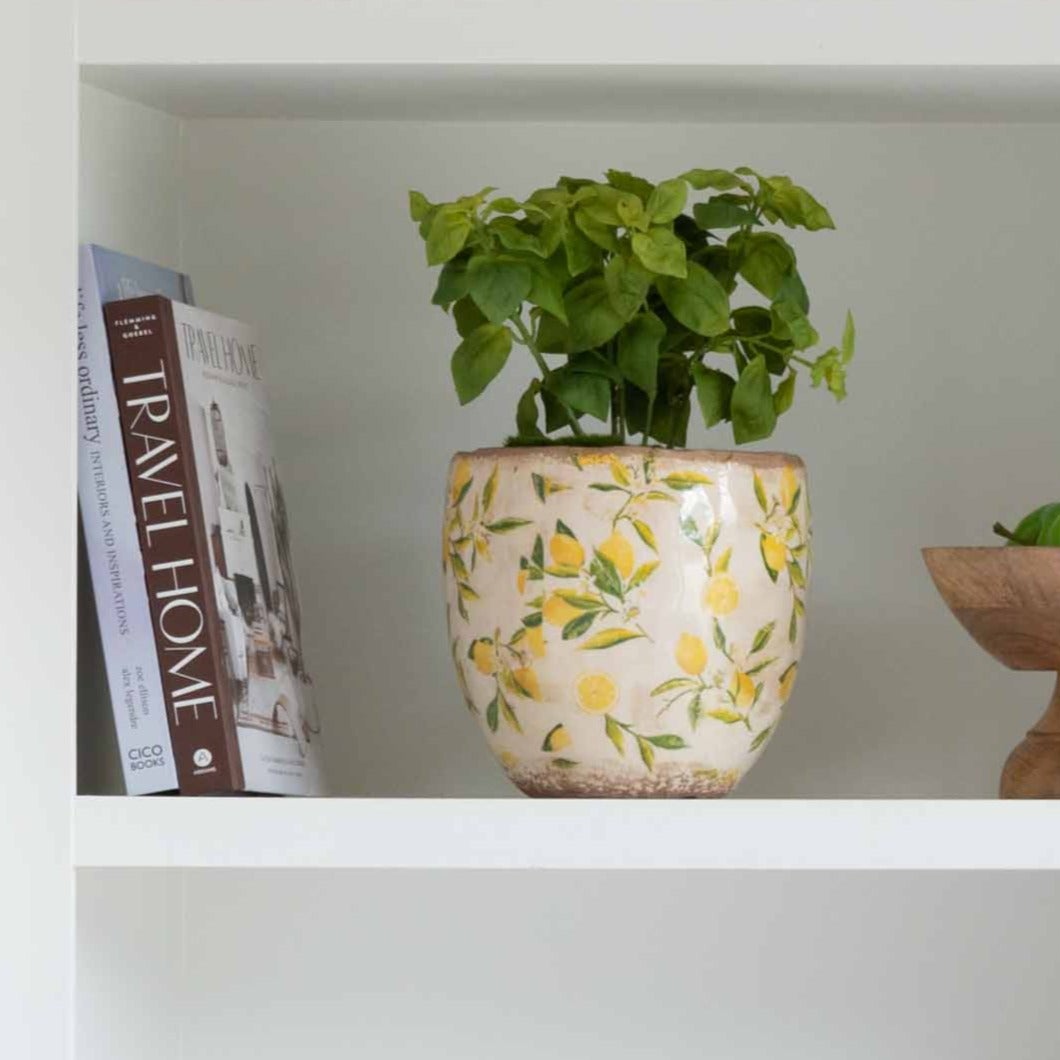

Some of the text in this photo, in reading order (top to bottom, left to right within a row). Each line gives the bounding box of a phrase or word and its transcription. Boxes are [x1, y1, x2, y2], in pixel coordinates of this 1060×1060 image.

[78, 366, 101, 443] ordinary
[90, 450, 110, 517] INTERIORS
[102, 520, 115, 547] AND
[123, 358, 218, 726] TRAVEL HOME
[106, 550, 129, 635] INSPIRATIONS
[128, 744, 163, 760] CICO
[130, 757, 166, 771] BOOKS
